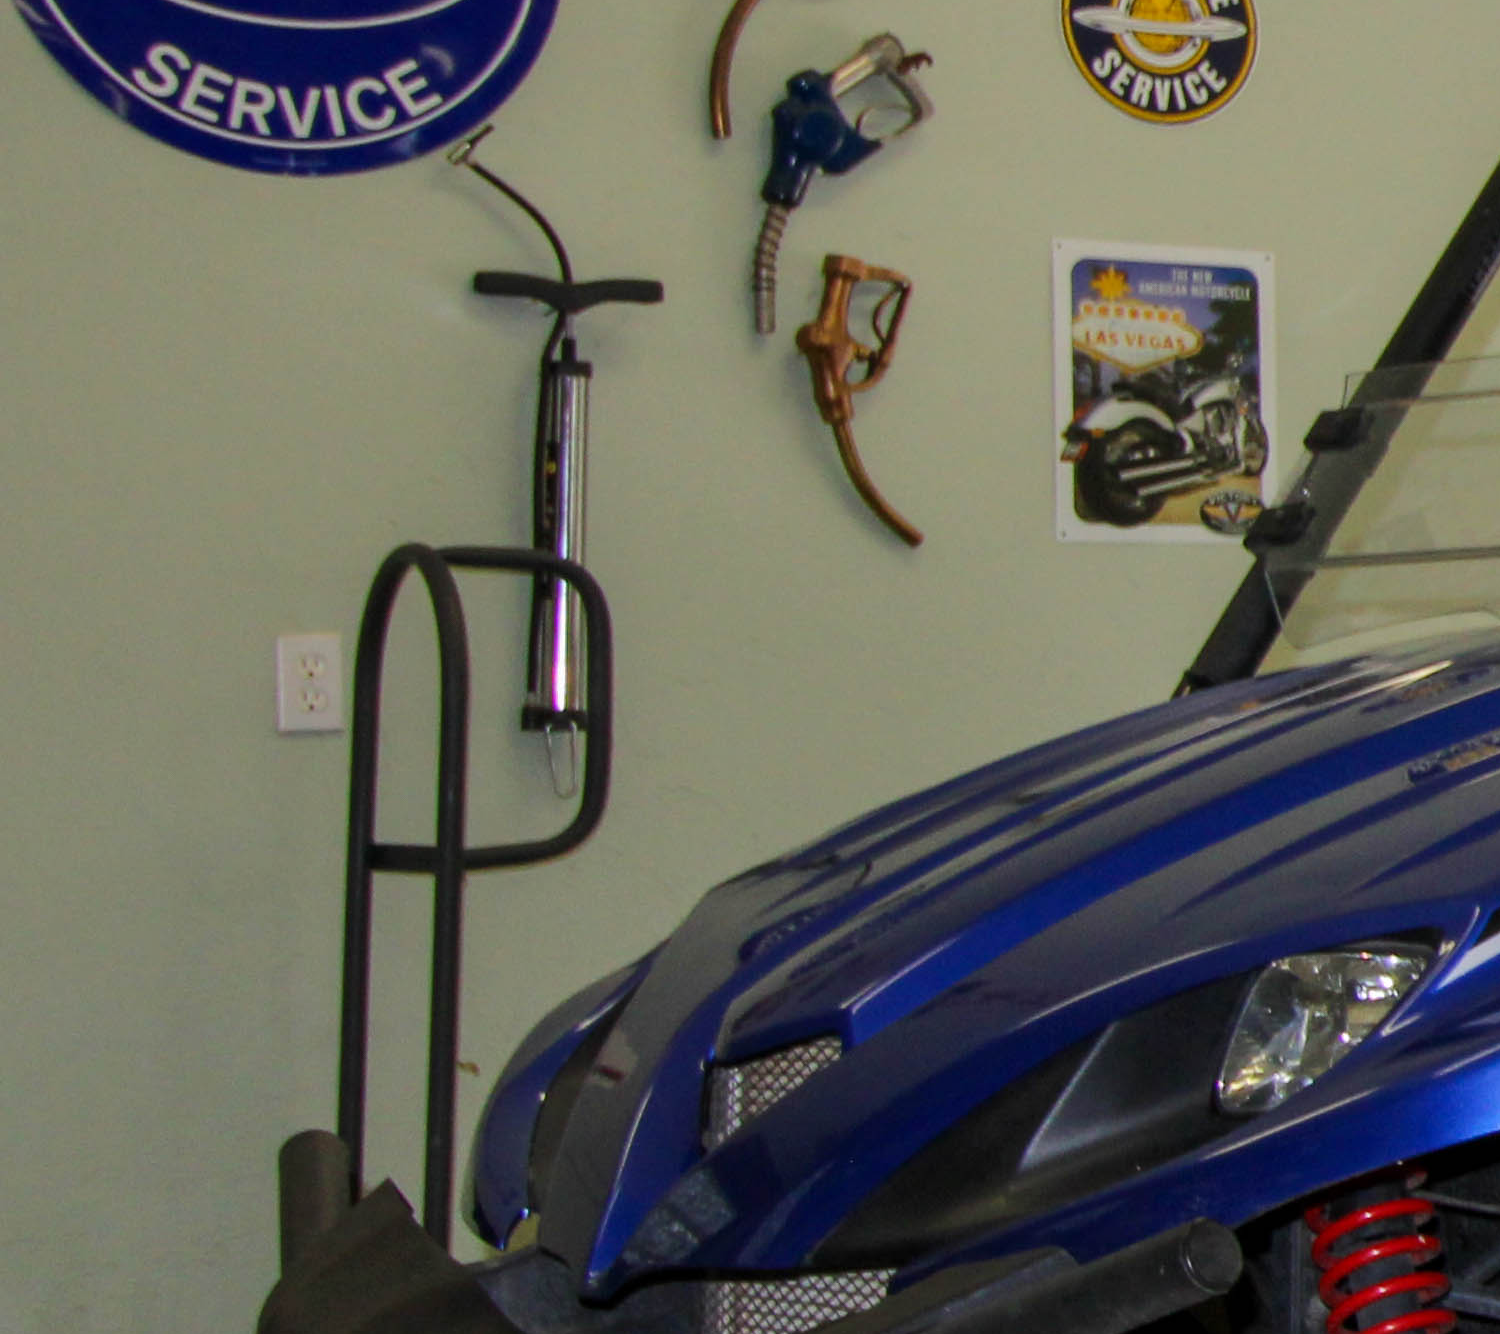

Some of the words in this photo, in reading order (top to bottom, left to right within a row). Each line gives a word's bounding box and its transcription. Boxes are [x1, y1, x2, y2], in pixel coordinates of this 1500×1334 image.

[132, 42, 443, 140] SERVICE
[1092, 47, 1227, 112] SERVICE
[1085, 330, 1118, 347] LAS
[1124, 330, 1187, 352] VEGAS
